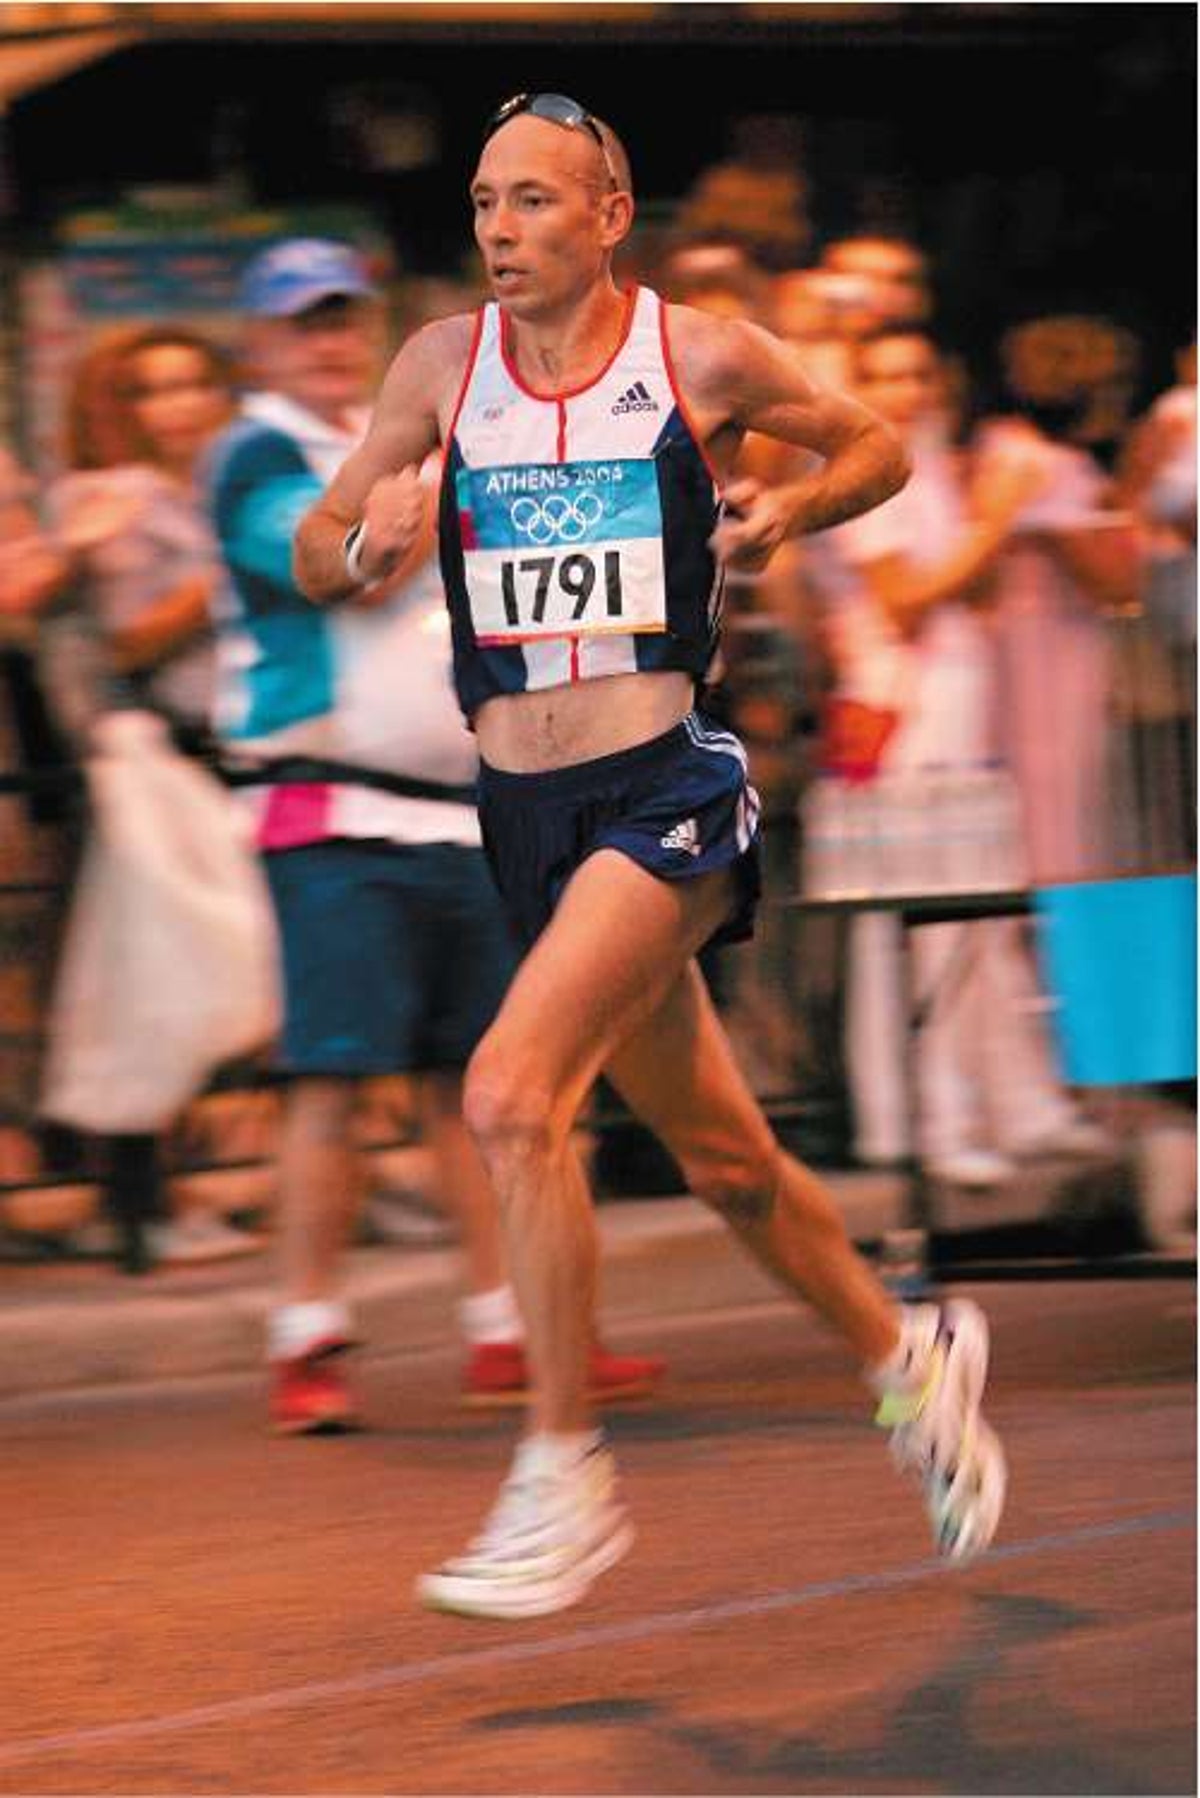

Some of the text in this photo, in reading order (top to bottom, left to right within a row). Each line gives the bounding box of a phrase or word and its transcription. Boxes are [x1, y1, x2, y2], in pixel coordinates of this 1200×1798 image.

[486, 463, 624, 495] ATHENS 2004
[501, 551, 623, 626] 1791
